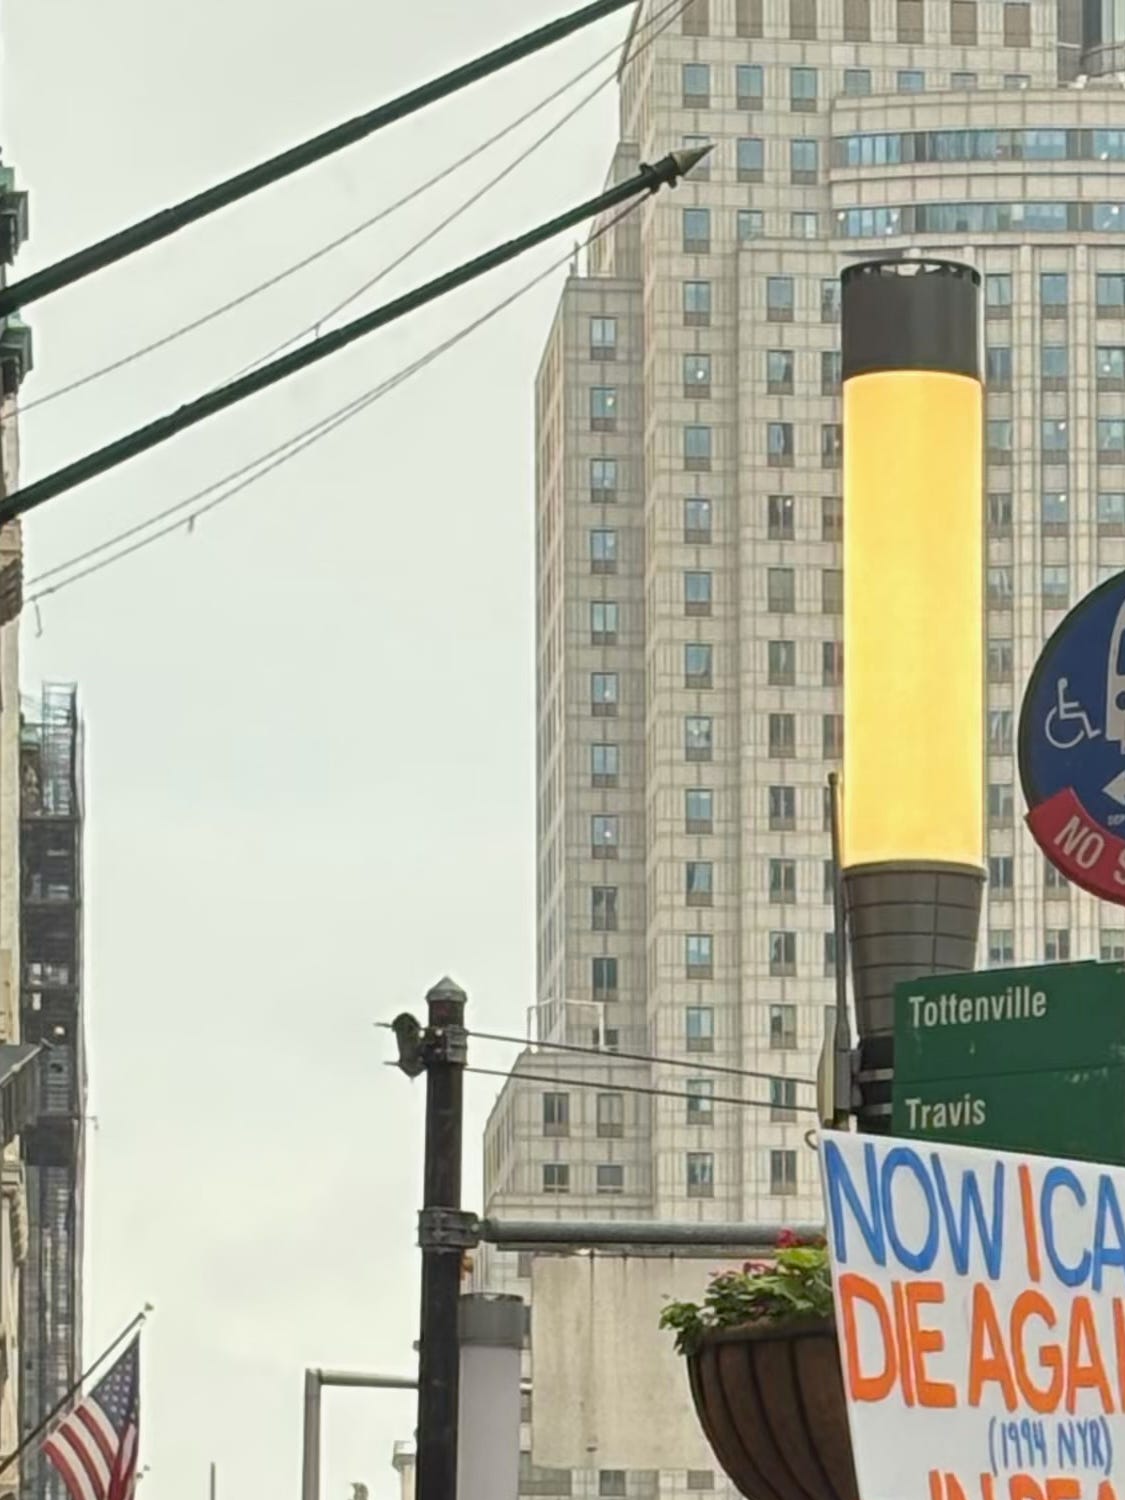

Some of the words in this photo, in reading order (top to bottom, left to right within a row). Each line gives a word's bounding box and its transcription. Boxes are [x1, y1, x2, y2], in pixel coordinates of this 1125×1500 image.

[1053, 814, 1106, 870] NO
[909, 985, 1047, 1028] Tottenville
[905, 1096, 986, 1130] Travis
[823, 1139, 1005, 1281] NOW
[1018, 1164, 1041, 1282] I
[837, 1272, 957, 1409] DIE
[988, 1415, 1047, 1476] (1994
[1057, 1416, 1112, 1476] NYR)
